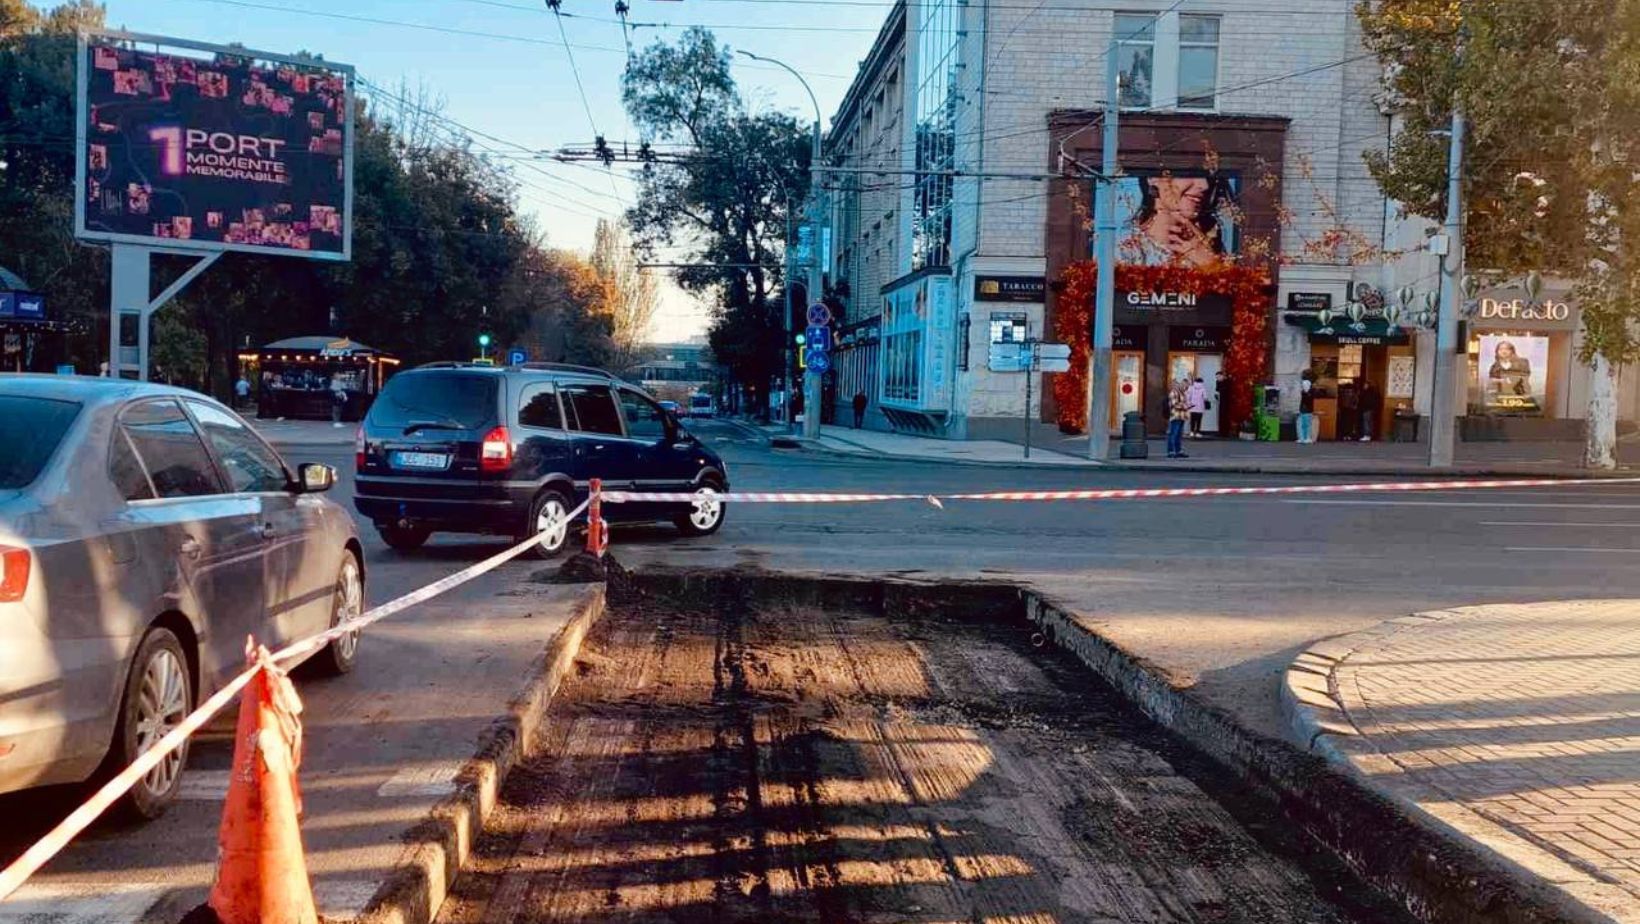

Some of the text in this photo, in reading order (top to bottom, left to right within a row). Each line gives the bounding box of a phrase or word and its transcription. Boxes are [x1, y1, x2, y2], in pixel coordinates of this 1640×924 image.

[148, 126, 285, 176] 1 PORT
[186, 154, 285, 173] MOMENTE
[186, 164, 286, 183] MEMORABILE
[1127, 292, 1197, 306] GEMENI
[1482, 298, 1569, 321] DeFacto
[512, 353, 524, 365] P
